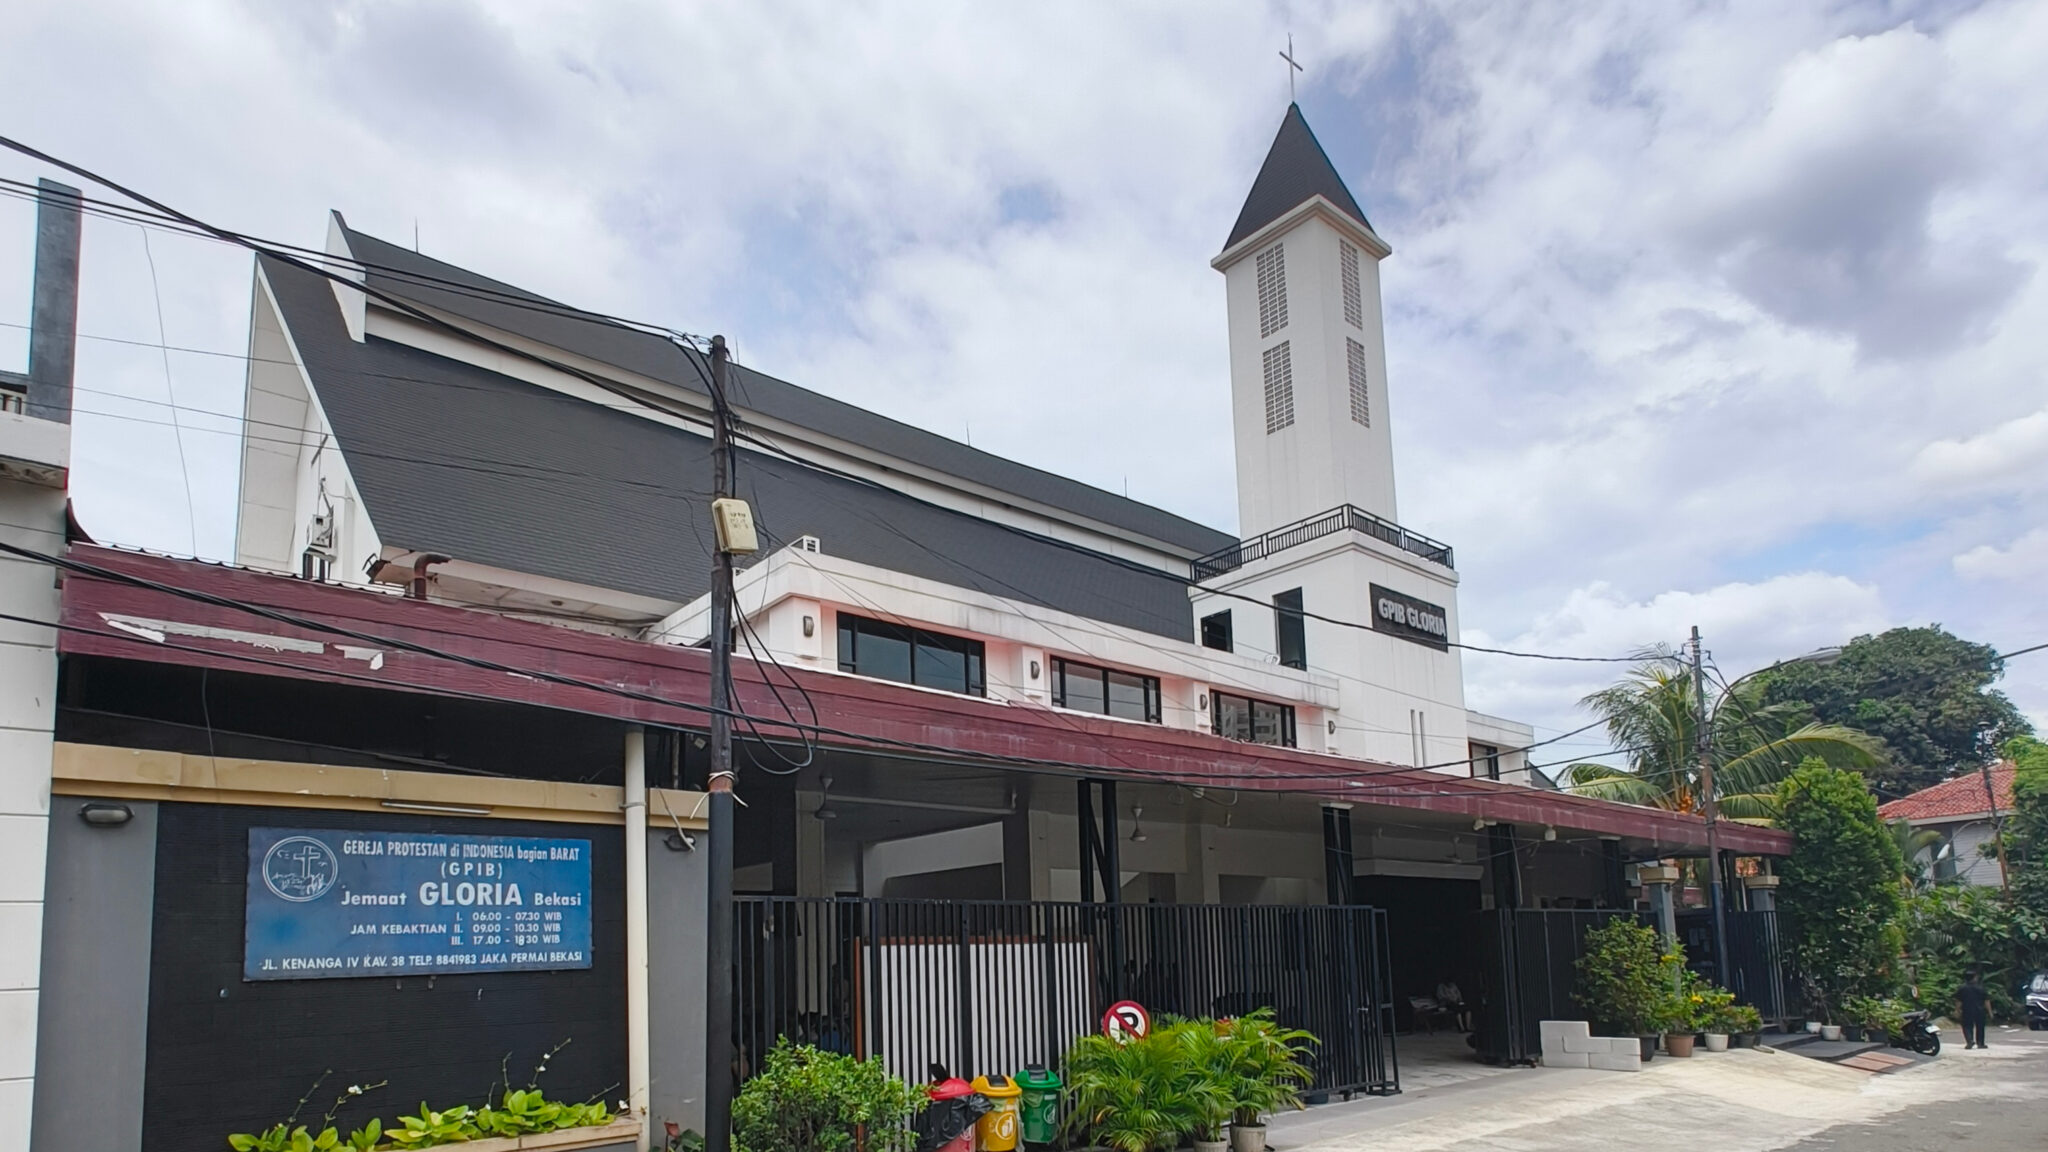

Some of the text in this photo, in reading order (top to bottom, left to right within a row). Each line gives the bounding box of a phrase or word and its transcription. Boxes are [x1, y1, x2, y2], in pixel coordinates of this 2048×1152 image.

[1378, 598, 1446, 637] GPIB GLORIA
[343, 840, 580, 863] GEREJA PROTESTAN di INDONESIA bagian BARAT
[341, 882, 582, 906] Jemaat GLORIA Bekasi
[472, 912, 502, 921] 06.00
[544, 912, 563, 921] WIB
[350, 924, 447, 935] JAM KEBAKTIAN
[472, 924, 502, 934] 09.00
[514, 924, 539, 933] 10.30
[543, 924, 562, 933] WIB
[542, 935, 561, 945] WIB
[262, 959, 278, 970] JL.
[282, 957, 343, 969] KENANGA
[347, 957, 360, 968] IV
[363, 956, 388, 968] KAV.
[391, 956, 405, 967] 38
[436, 954, 477, 966] 8841983
[480, 953, 508, 964] JAKA
[511, 952, 548, 963] PERMAI
[550, 951, 582, 962] BEKASI
